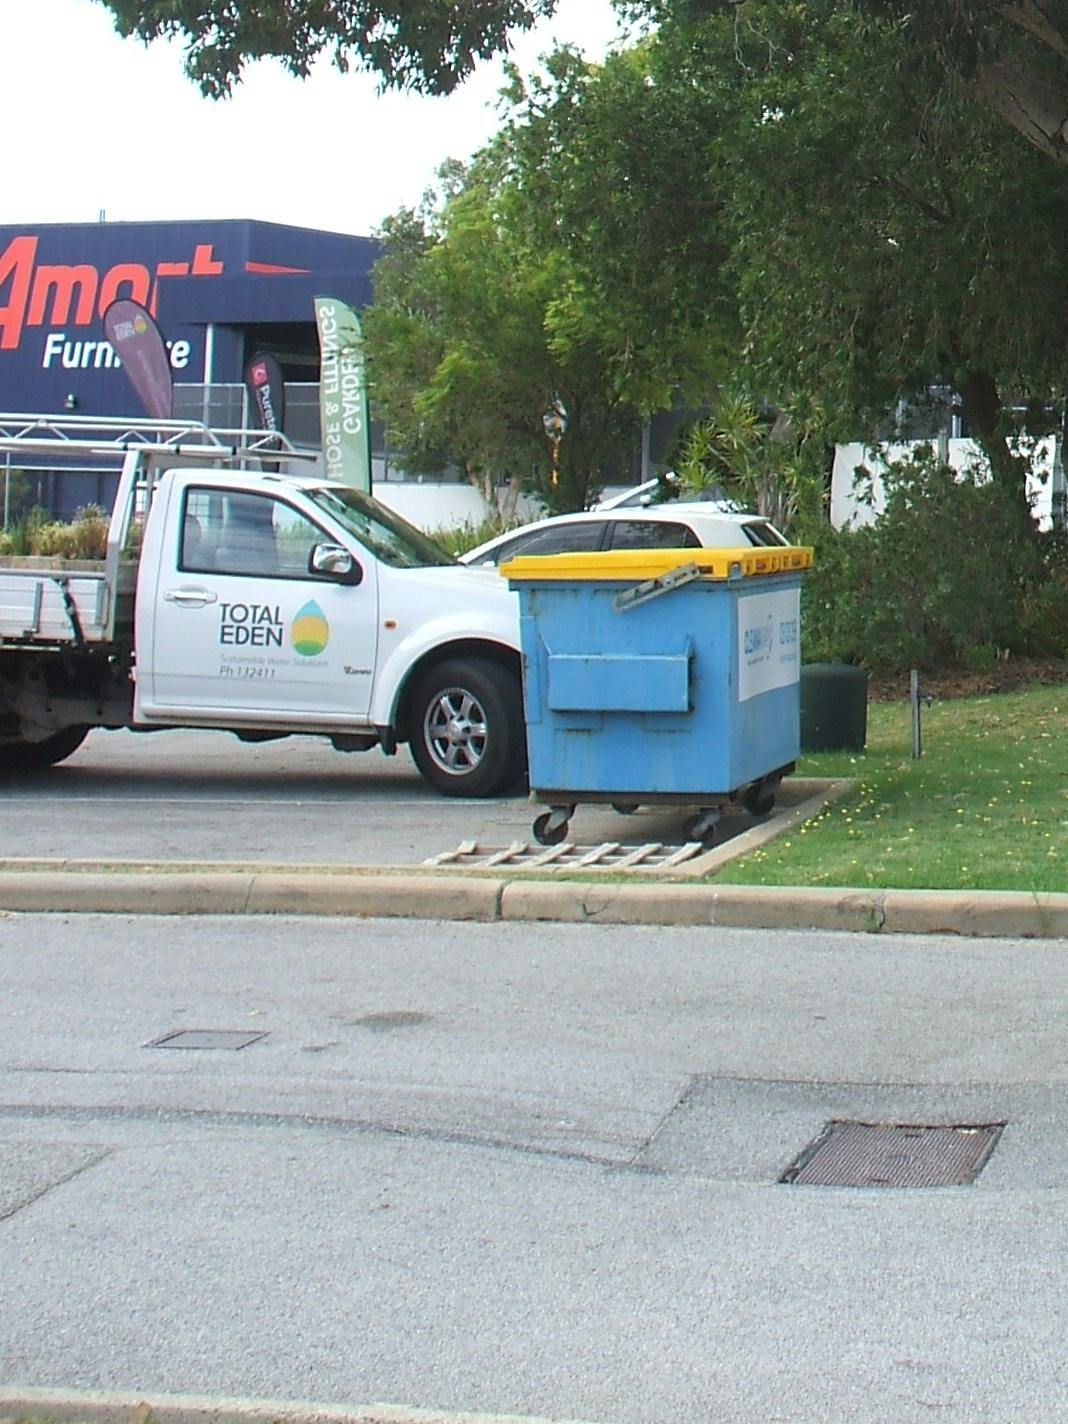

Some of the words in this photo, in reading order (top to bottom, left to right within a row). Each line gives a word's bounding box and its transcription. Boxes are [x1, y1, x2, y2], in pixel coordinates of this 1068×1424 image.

[43, 334, 190, 368] Furne
[220, 603, 284, 626] TOTAL
[220, 625, 283, 648] EDEN
